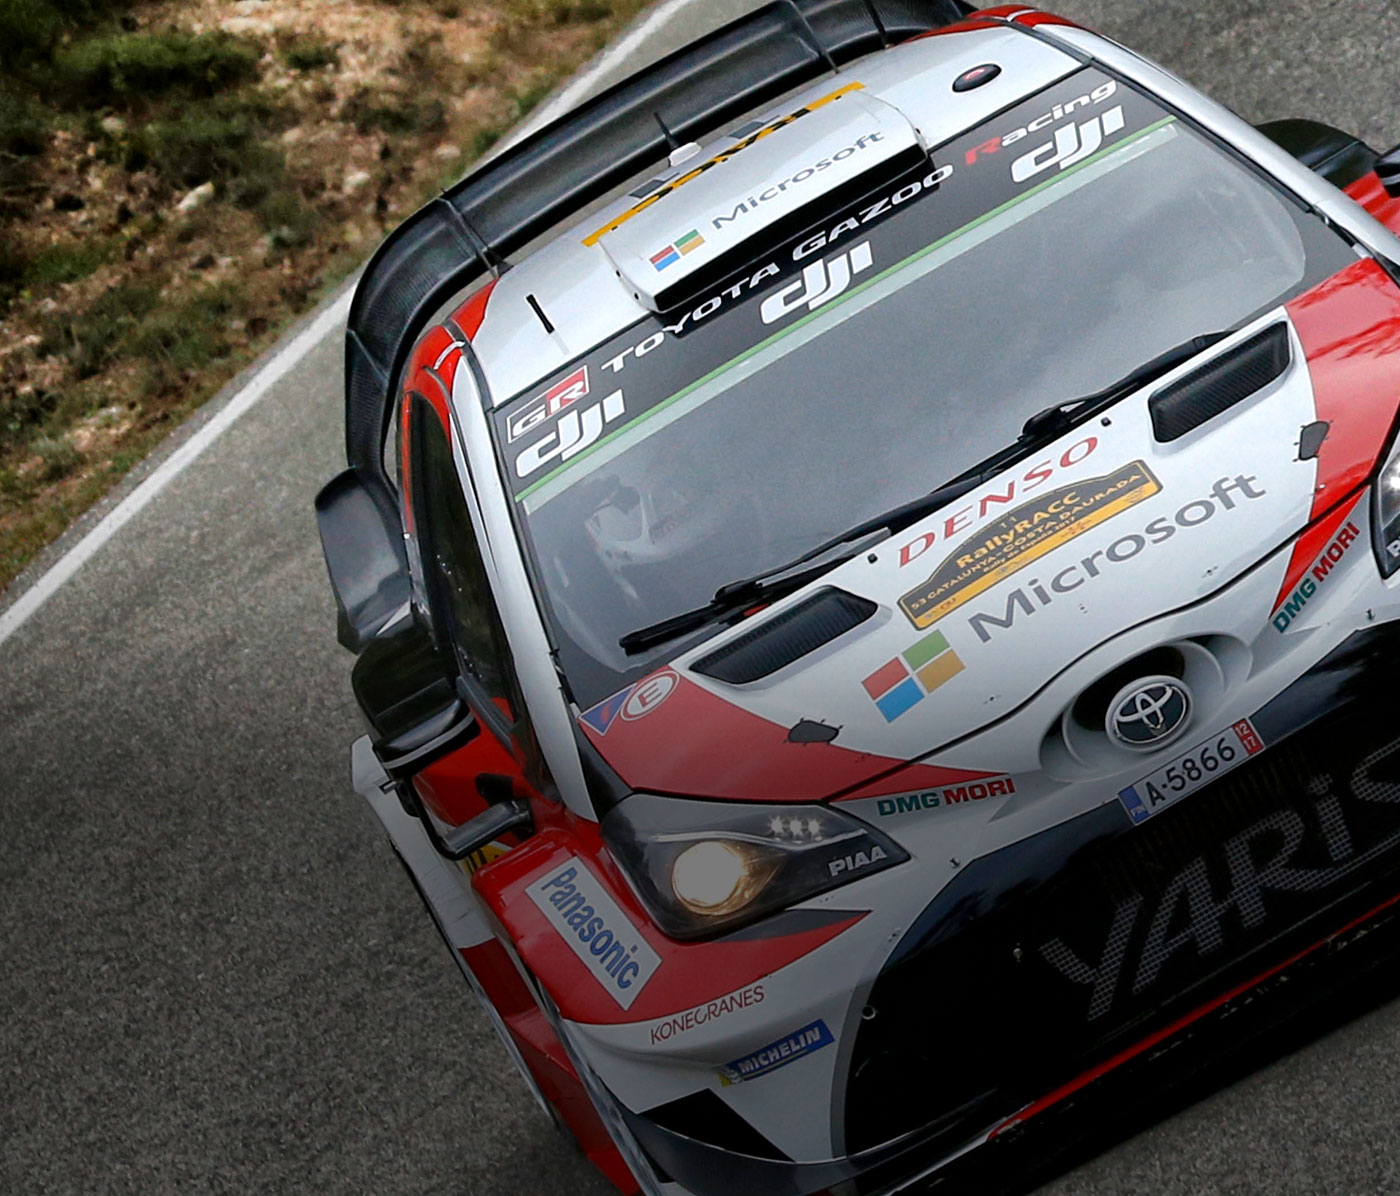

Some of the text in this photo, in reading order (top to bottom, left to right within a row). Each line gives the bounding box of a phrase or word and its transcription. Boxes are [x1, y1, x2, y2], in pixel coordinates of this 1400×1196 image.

[711, 131, 885, 230] Microsoft
[601, 79, 1117, 373] TOYOTA GAZOO Racing
[512, 380, 585, 437] GR
[898, 436, 1099, 568] DENSO
[1059, 474, 1142, 520] DAURADA
[956, 491, 1081, 568] RallyRACC
[968, 473, 1267, 644] Microsoft
[1272, 522, 1361, 633] DMG MORI
[1235, 722, 1251, 736] 12
[1242, 735, 1258, 749] 17
[877, 778, 1016, 817] DMG MORI
[827, 845, 888, 877] PIAA
[540, 866, 640, 990] Panasonic
[649, 985, 765, 1046] KONECRANES
[737, 1026, 821, 1073] MICHELIN
